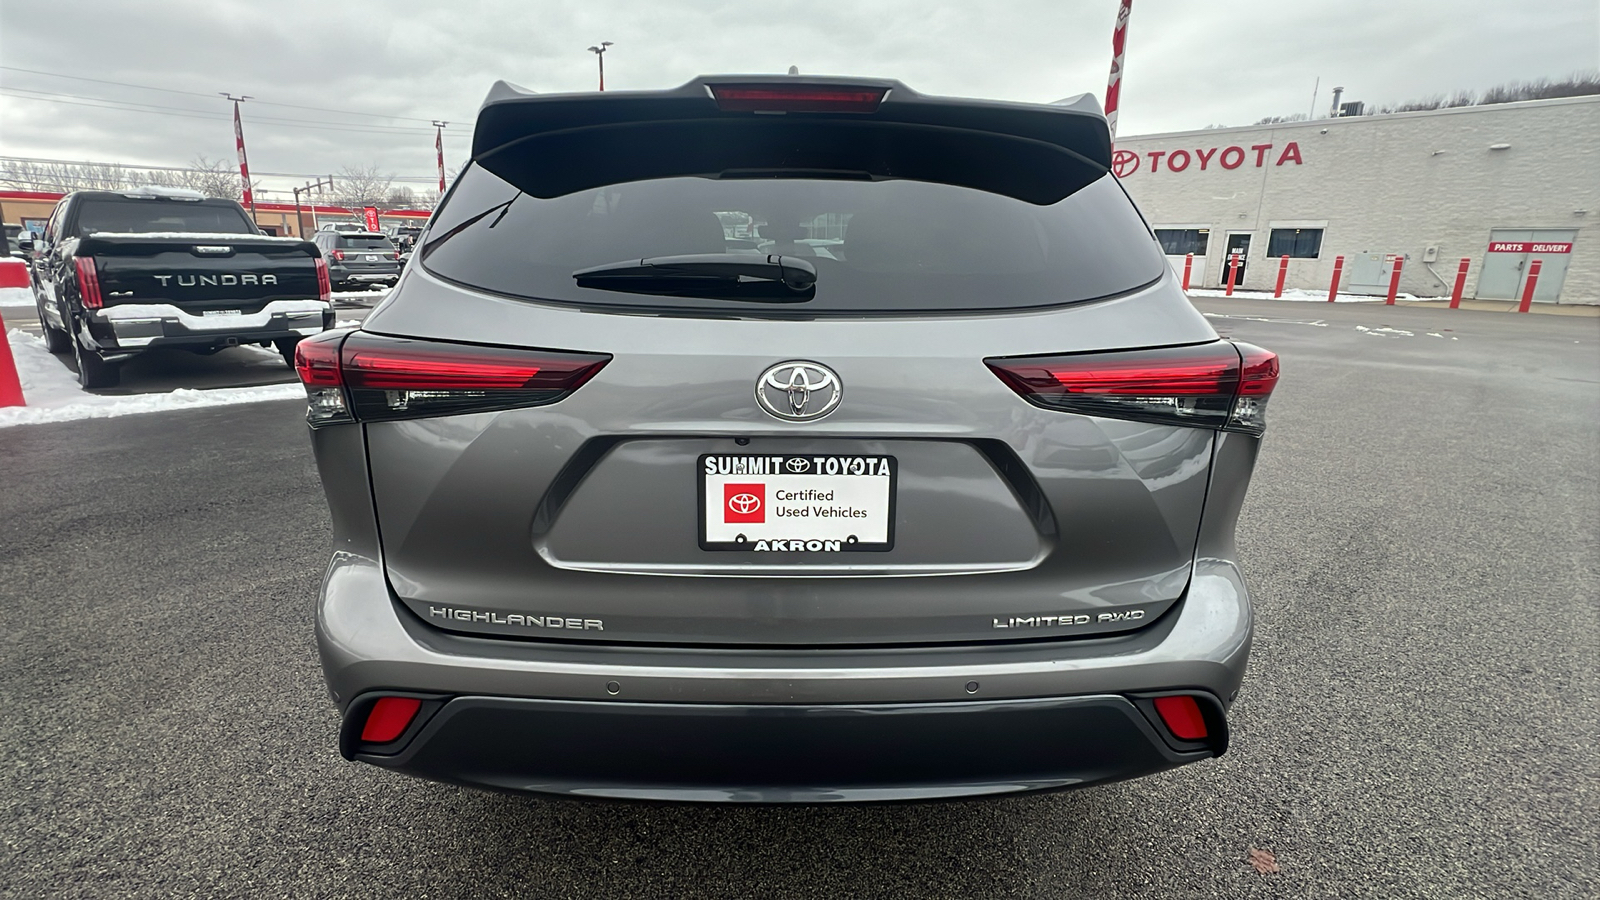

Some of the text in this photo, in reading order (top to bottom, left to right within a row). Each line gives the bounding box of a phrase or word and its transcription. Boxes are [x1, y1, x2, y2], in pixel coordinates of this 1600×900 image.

[1147, 142, 1303, 173] TOYOTA
[1494, 243, 1569, 252] PARTS DELIVERY
[154, 274, 278, 287] TUNDRA
[705, 456, 890, 476] SUMMIT TOYOTA
[775, 489, 834, 501] Certified
[775, 506, 867, 518] Used Vehicles
[754, 539, 841, 551] AKRON
[429, 606, 604, 631] HIGHLANDER
[992, 610, 1145, 628] LIMITED AWD
